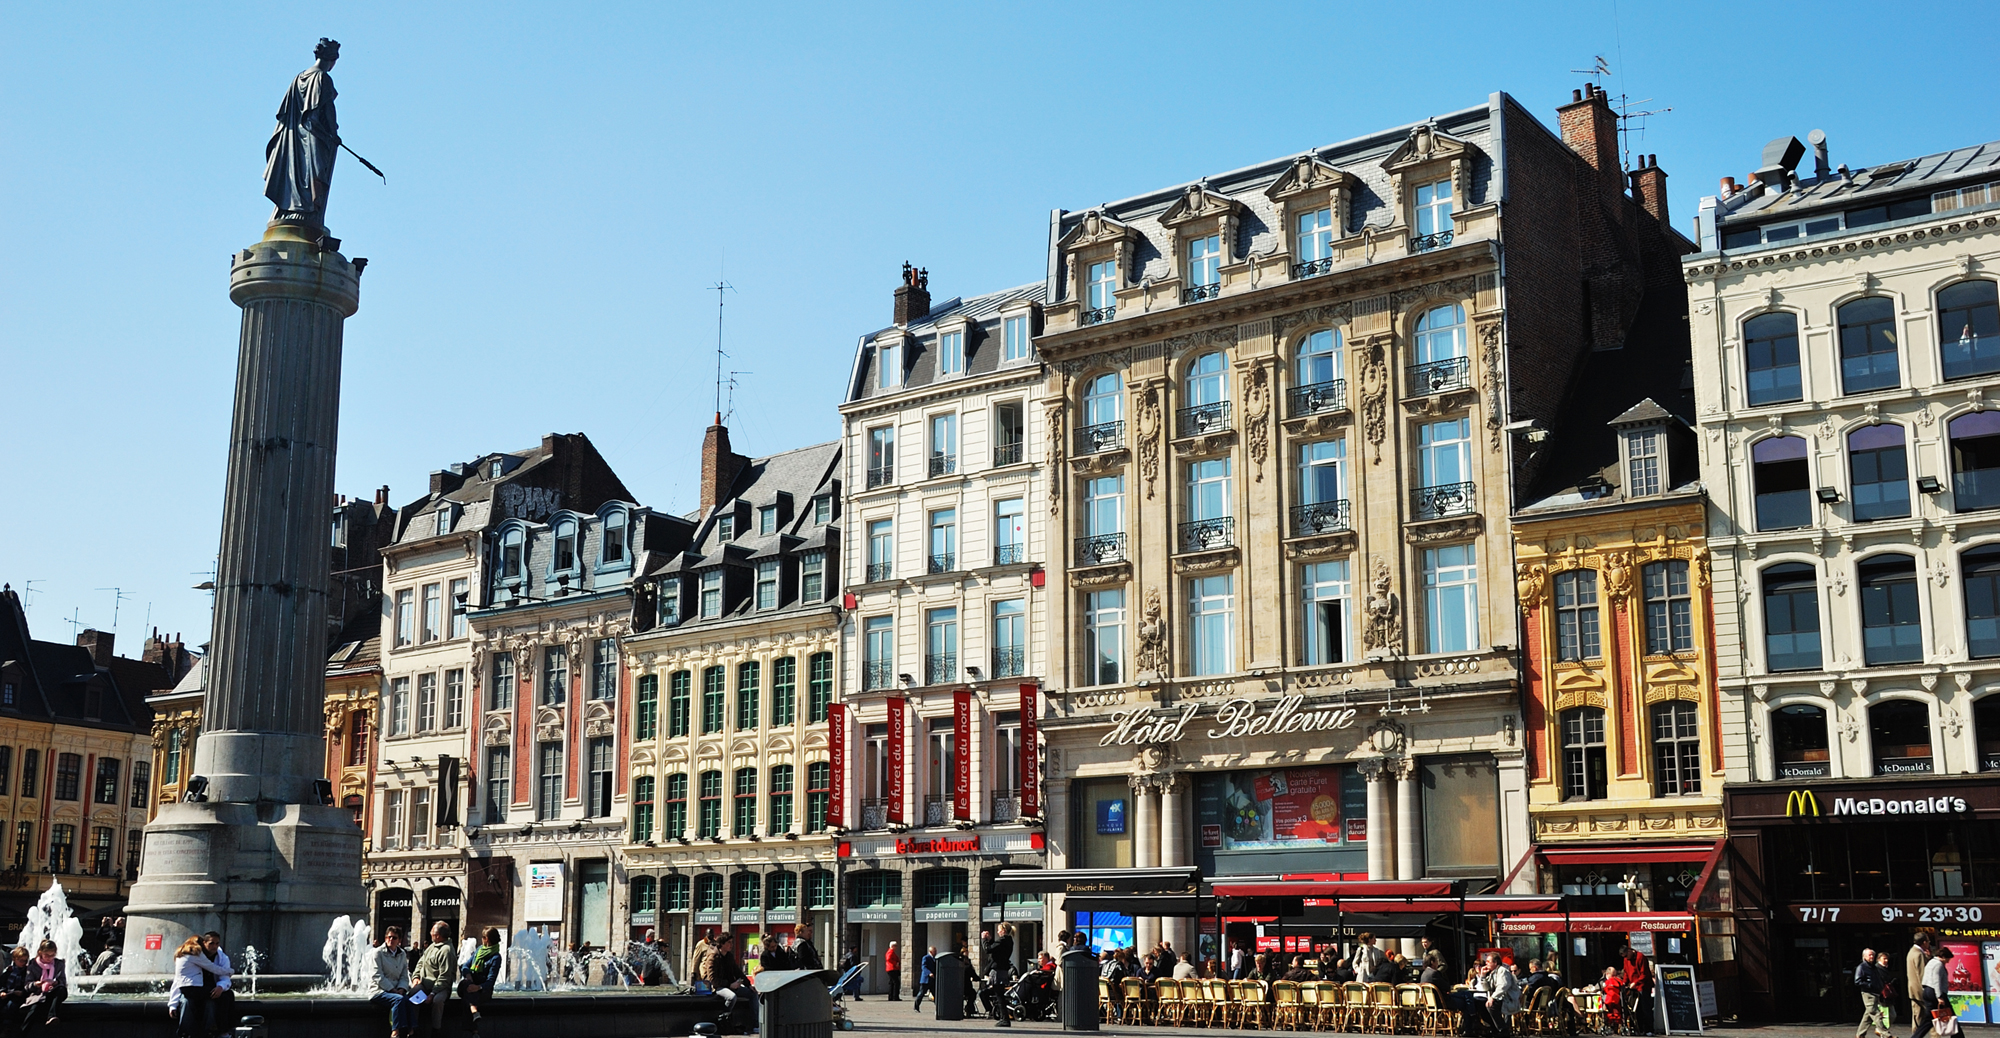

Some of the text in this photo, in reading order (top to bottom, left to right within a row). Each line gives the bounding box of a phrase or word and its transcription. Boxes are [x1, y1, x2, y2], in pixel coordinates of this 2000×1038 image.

[1099, 694, 1357, 747] Hôtel Bellevue
[957, 702, 968, 810] le furet du nord
[1025, 696, 1035, 807] le furet du nord
[890, 708, 901, 813] le furet du nord
[1985, 759, 2000, 768] Mc
[832, 714, 841, 817] le furet du nord
[1879, 763, 1931, 773] McDonald's
[1290, 770, 1320, 779] Nouvelle
[1290, 777, 1327, 787] carte Furet
[1290, 786, 1317, 796] gratuite
[1834, 796, 1967, 816] McDonald's
[896, 838, 906, 854] le
[936, 837, 949, 852] du
[951, 835, 980, 852] nord
[1066, 882, 1114, 892] Patisserie Fine
[383, 899, 413, 908] SEPHORA
[430, 898, 460, 907] SEPHORA
[768, 913, 795, 921] créatives
[861, 912, 888, 920] librairie
[925, 911, 958, 920] papeterie
[993, 910, 1032, 918] mltimédia
[1881, 907, 1903, 922] 9h
[1918, 906, 1953, 922] 23h
[1955, 907, 1982, 922] 30
[632, 916, 654, 924] voyages
[8, 923, 26, 931] BRA
[1500, 923, 1535, 931] Brasserie
[1640, 921, 1686, 930] Restaurant
[1332, 927, 1356, 935] PUL
[1962, 929, 1973, 937] Le
[1973, 928, 1989, 936] Wifi
